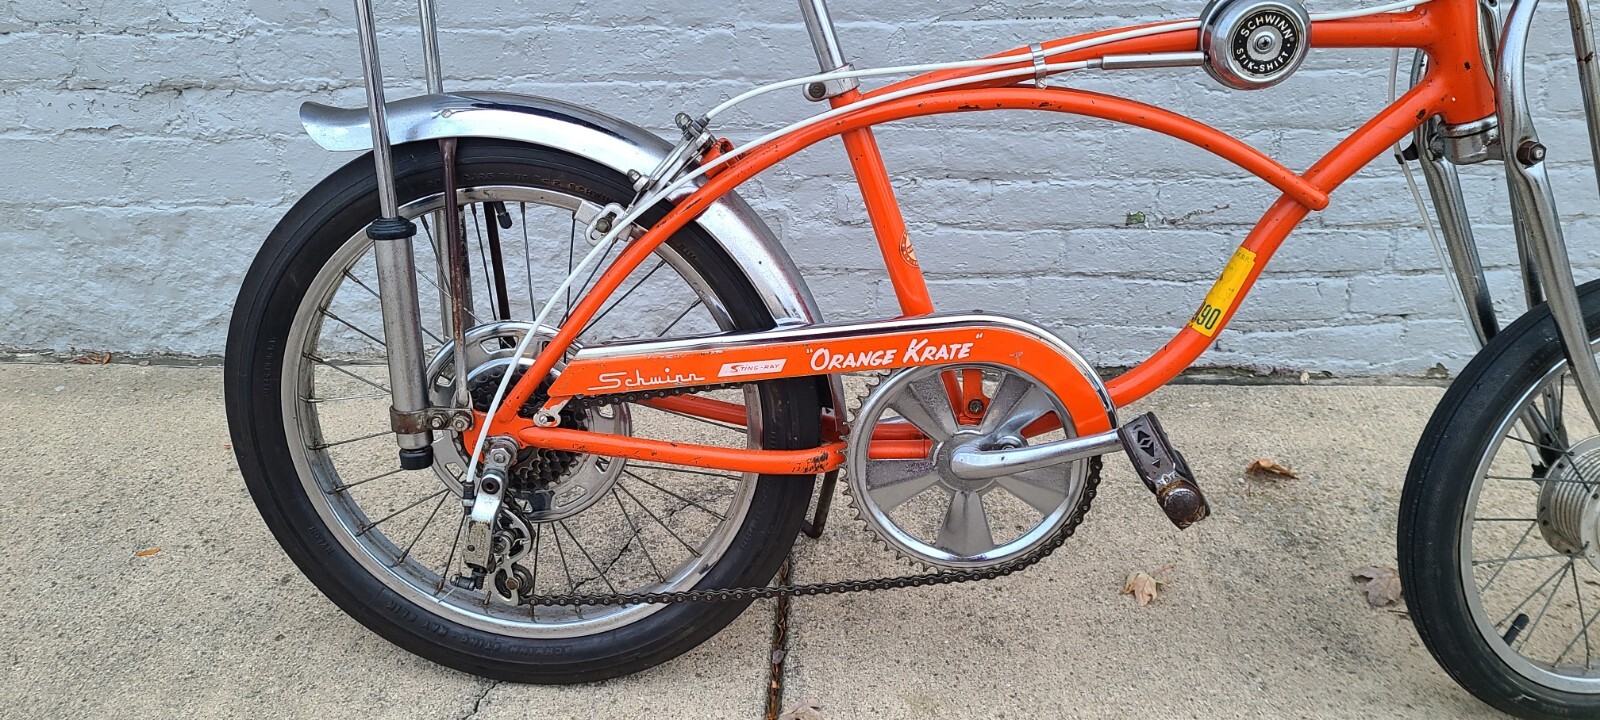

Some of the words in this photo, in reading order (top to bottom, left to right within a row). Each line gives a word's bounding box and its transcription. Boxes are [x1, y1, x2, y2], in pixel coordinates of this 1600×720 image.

[1236, 48, 1289, 72] STIK-SHIFT
[587, 367, 705, 391] Schwinn
[731, 364, 780, 373] STING-RAY
